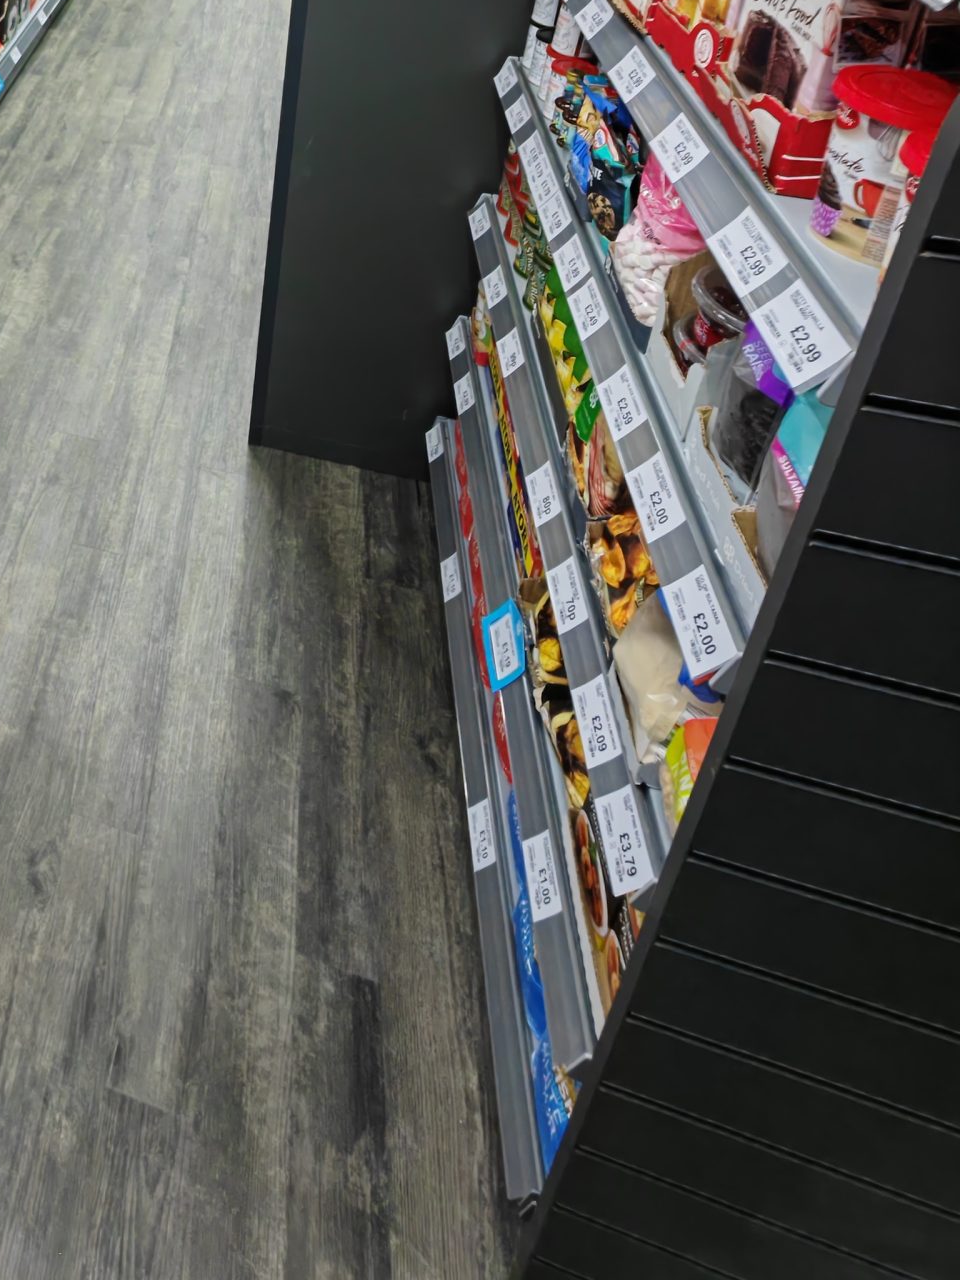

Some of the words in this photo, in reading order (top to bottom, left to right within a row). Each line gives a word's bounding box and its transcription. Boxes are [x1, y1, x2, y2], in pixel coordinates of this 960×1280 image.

[628, 70, 644, 88] £2.99
[674, 142, 694, 166] £2.99
[739, 245, 767, 276] £2.99
[583, 303, 597, 327] £2.49
[790, 325, 822, 364] £2.99
[616, 397, 633, 426] £2.59
[542, 495, 552, 516] 80p
[649, 490, 670, 525] £2.00
[512, 491, 530, 552] ATORA
[565, 598, 576, 621] 70p
[691, 612, 717, 656] £2.00
[501, 641, 512, 669] £1.19
[591, 715, 607, 753] £2.09
[479, 830, 488, 860] £1.10
[619, 832, 638, 877] £3.79
[539, 869, 551, 905] £1.00
